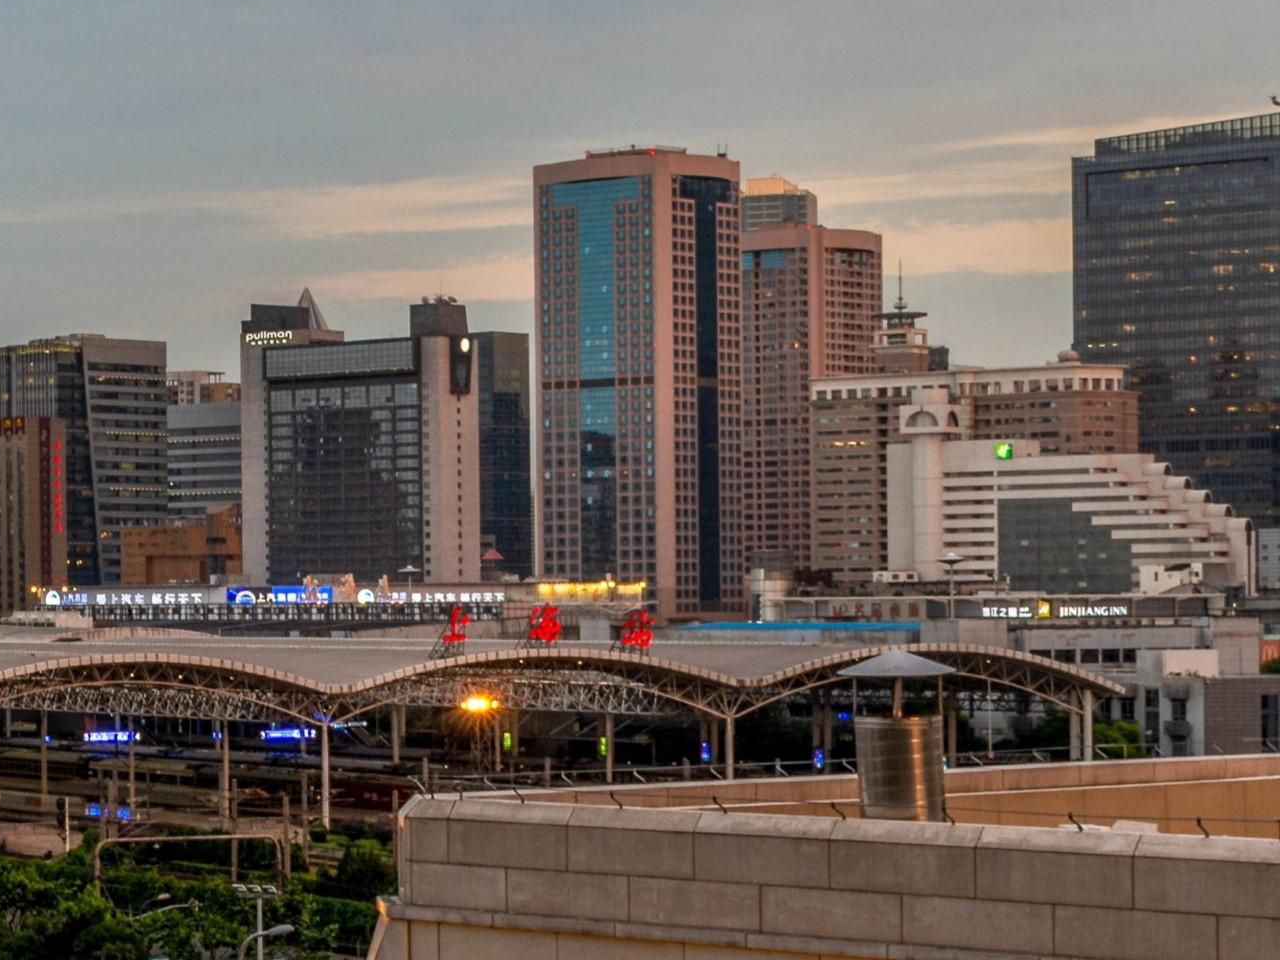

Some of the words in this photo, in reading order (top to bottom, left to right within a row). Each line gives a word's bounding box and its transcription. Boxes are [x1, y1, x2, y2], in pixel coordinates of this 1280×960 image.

[246, 330, 292, 343] pullman
[1059, 606, 1108, 617] JINJIANG
[1109, 606, 1128, 616] INN
[442, 603, 654, 648] 上海站
